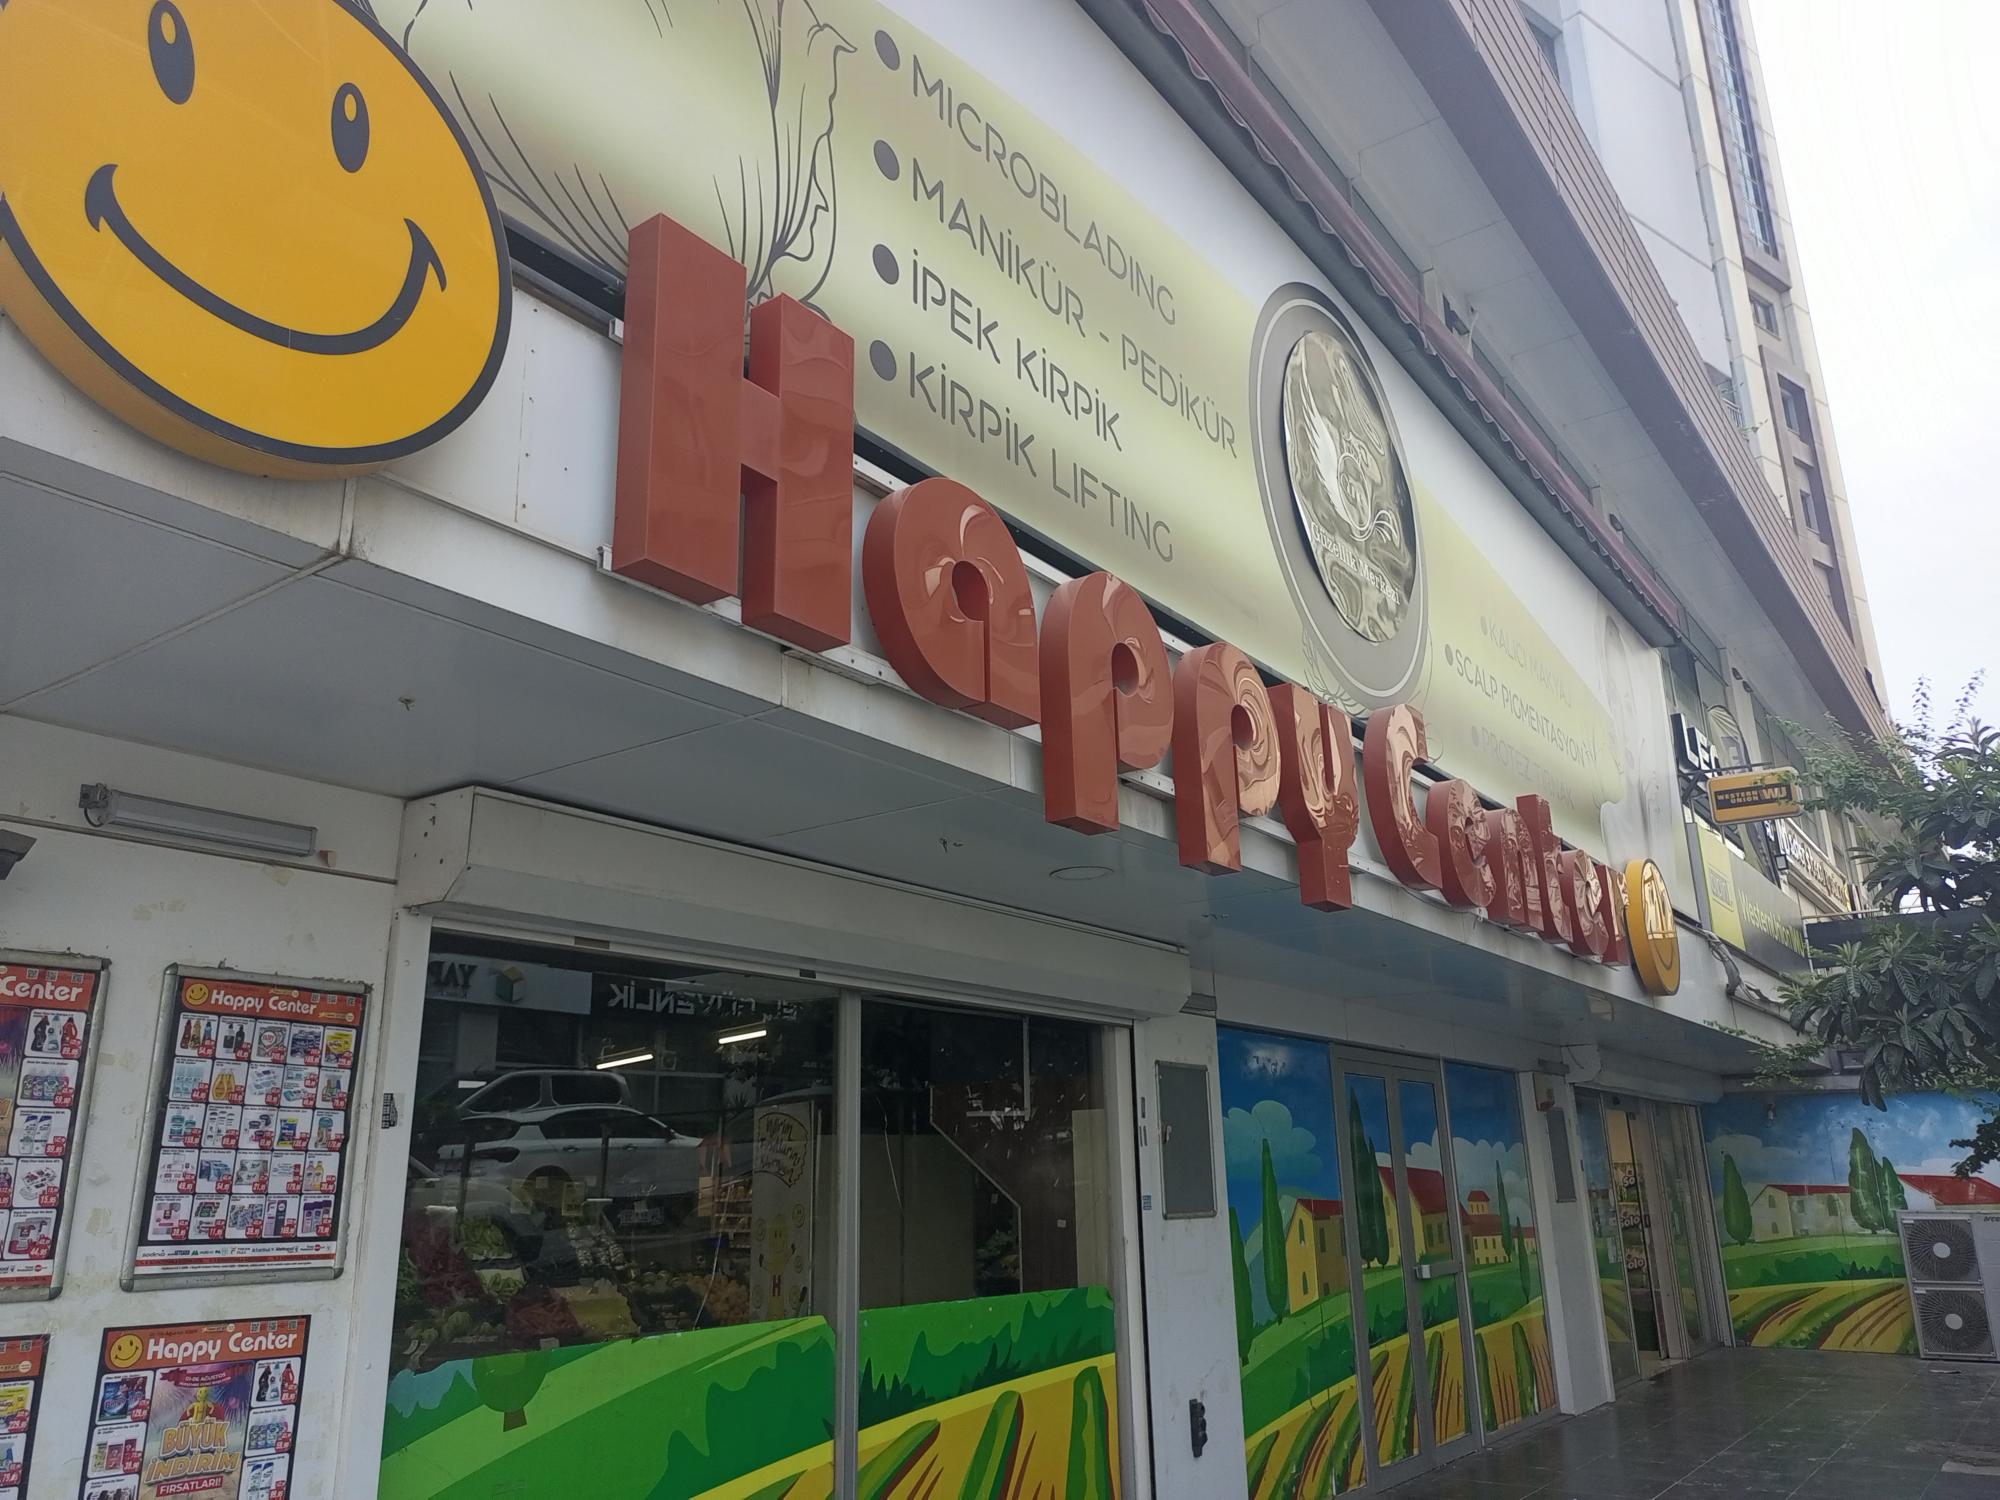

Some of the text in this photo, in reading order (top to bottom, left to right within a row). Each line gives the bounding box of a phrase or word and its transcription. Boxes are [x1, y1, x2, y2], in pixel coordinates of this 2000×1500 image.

[913, 54, 1176, 325] MICROBLADING
[913, 158, 1086, 339] MANİKÜR
[1121, 333, 1238, 459] PEDİKÜR
[912, 248, 1123, 453] İPEK KİRPİK
[909, 351, 1174, 563] KİRPİK LIFTING
[1311, 521, 1400, 605] Güzellik Merkezi
[612, 213, 1628, 966] Happy Center
[1455, 649, 1498, 700] SCALP
[1717, 786, 1787, 801] WESTERN WU
[1730, 795, 1759, 804] UNION
[0, 975, 83, 1002] Center
[210, 989, 264, 1012] Happy
[268, 996, 317, 1015] Center
[147, 1332, 298, 1364] Happy Center
[161, 1417, 230, 1455] BÜYÜK
[146, 1452, 241, 1481] İNDİRİM
